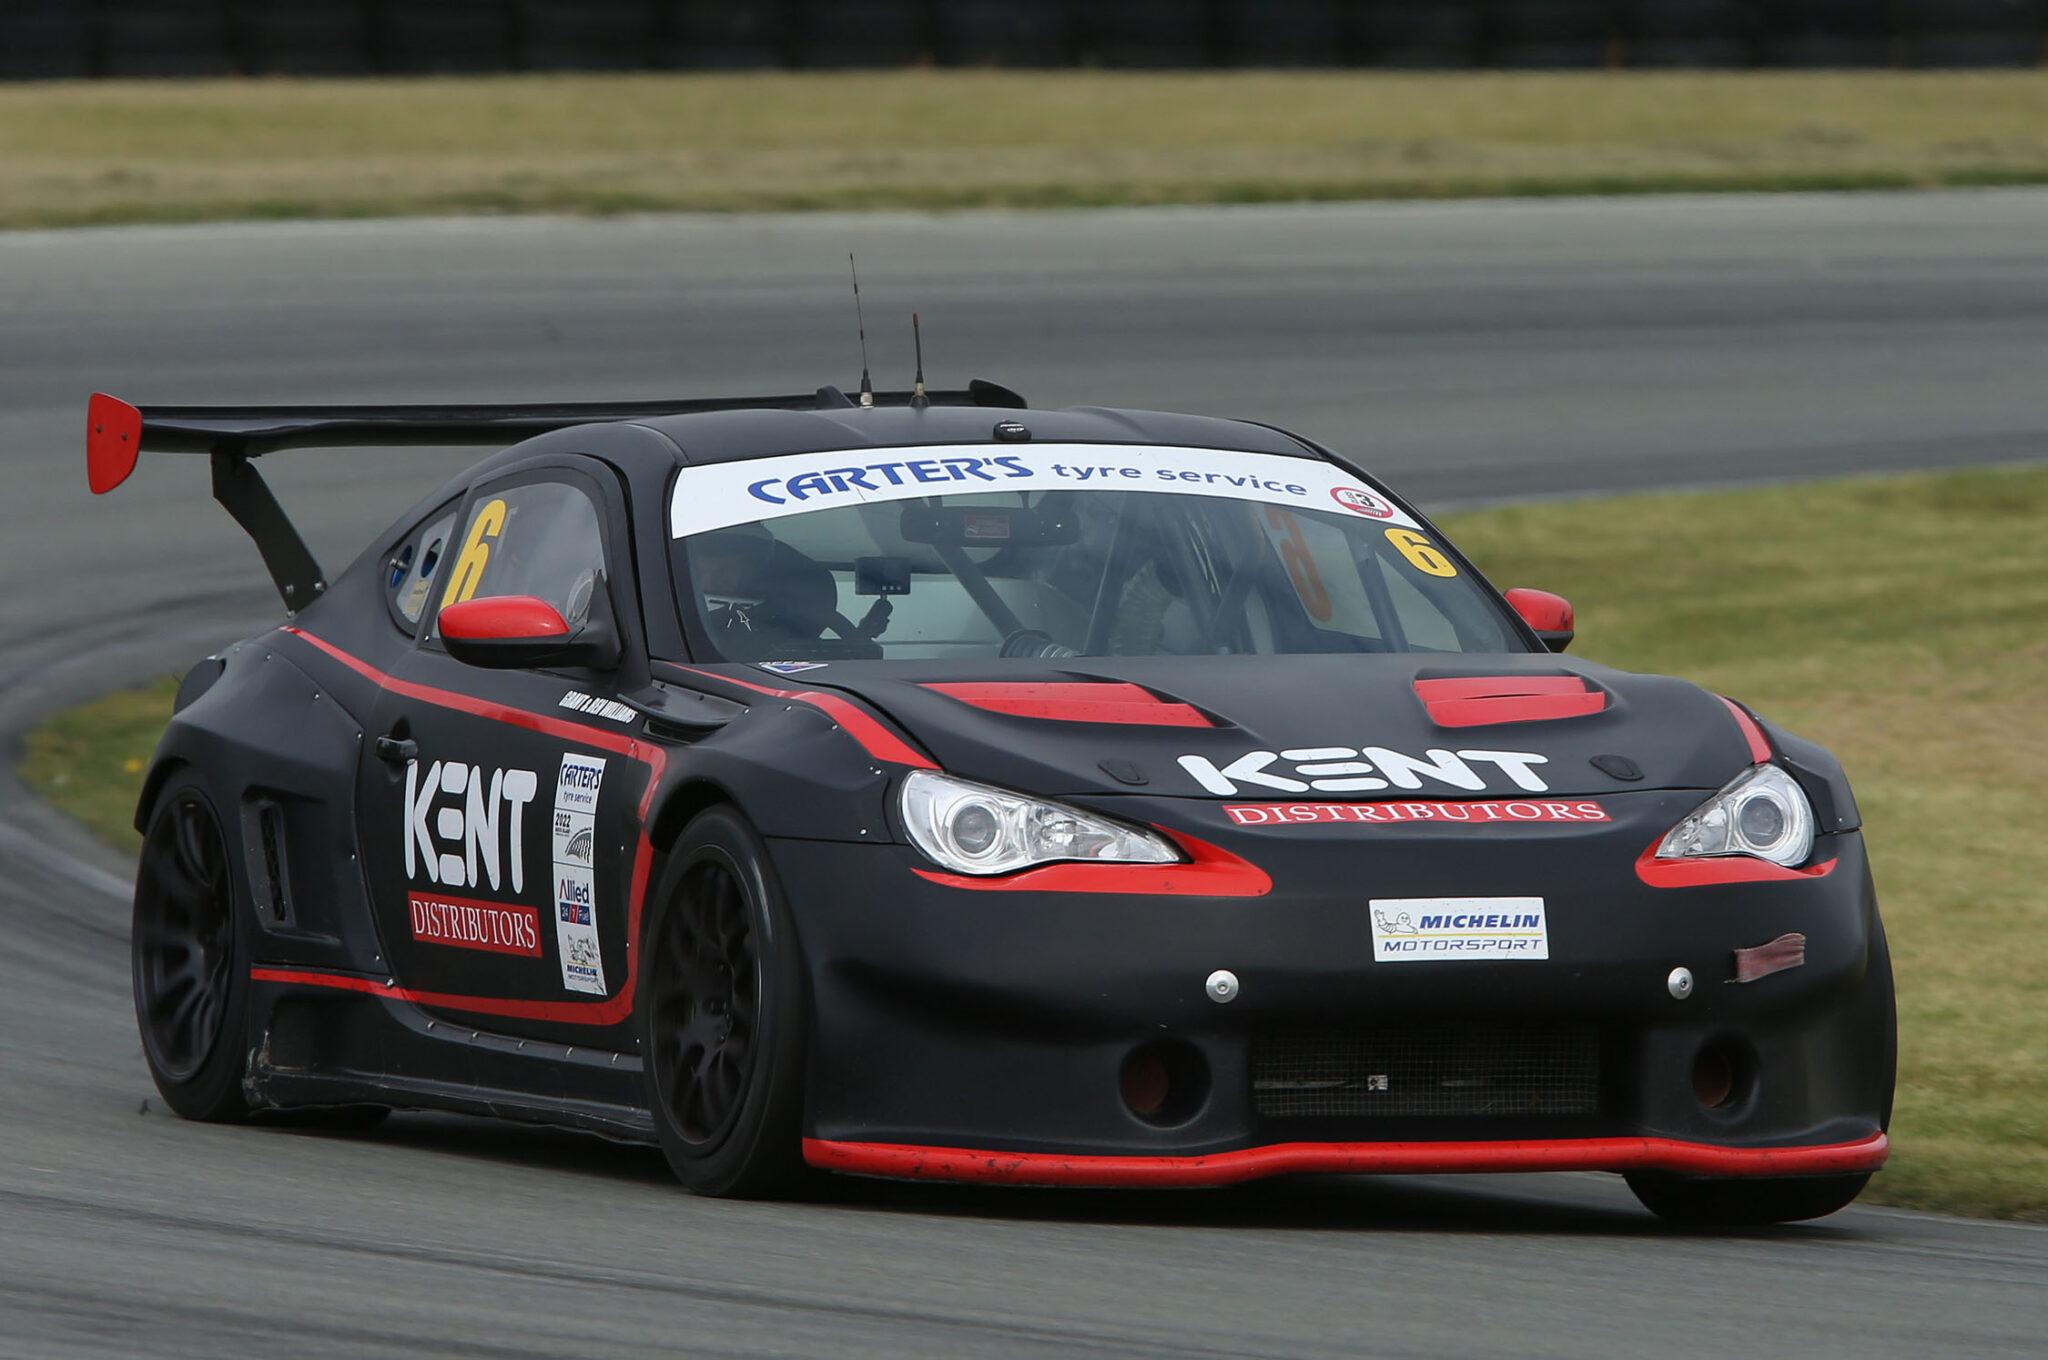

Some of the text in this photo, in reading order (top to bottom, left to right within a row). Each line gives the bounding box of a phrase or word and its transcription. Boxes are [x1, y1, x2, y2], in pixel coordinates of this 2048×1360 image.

[747, 456, 1308, 505] CARTER'S tyre service
[440, 499, 507, 610] 6
[1384, 528, 1458, 578] 6
[1177, 746, 1549, 796] KENT
[563, 791, 592, 805] tyre service
[1227, 801, 1607, 826] DISTRIBUTORS
[404, 759, 538, 894] KENT
[560, 879, 590, 904] Allied
[411, 899, 536, 950] DISTRIBUTORS
[1384, 938, 1543, 952] MOTORSPORT
[1419, 914, 1540, 929] MICHELIN
